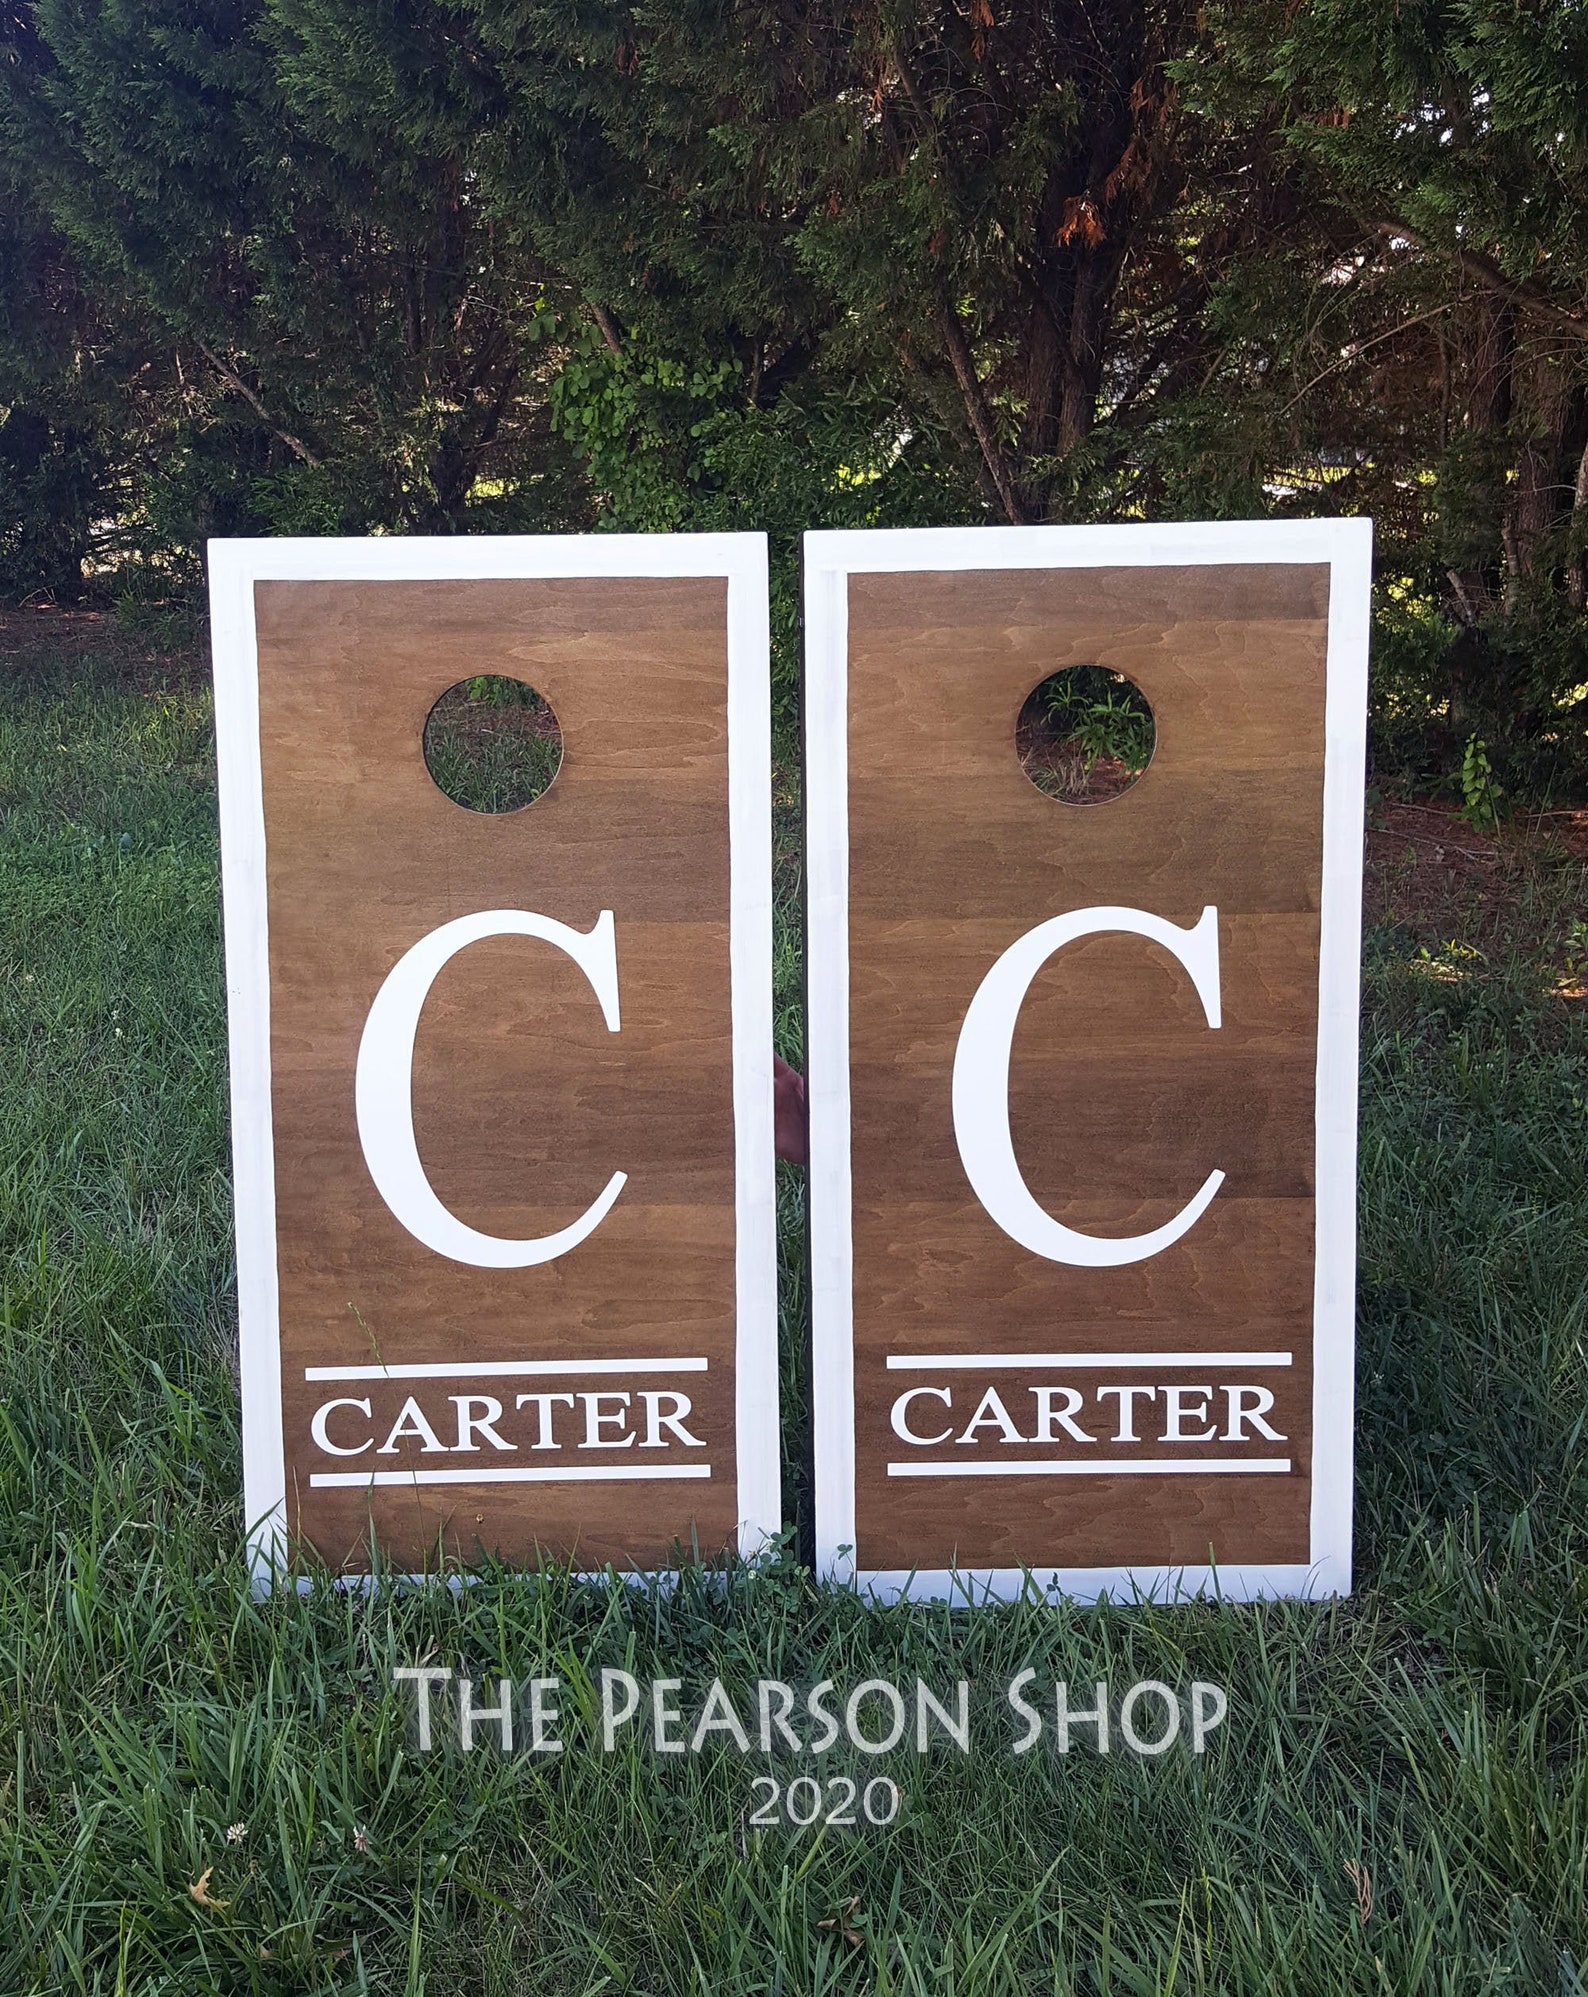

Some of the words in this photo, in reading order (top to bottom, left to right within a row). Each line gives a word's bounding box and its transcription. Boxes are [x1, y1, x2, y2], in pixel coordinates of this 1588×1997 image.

[355, 909, 627, 1269] C
[952, 906, 1225, 1267] C
[310, 1391, 707, 1456] CARTER
[891, 1385, 1288, 1445] CARTER
